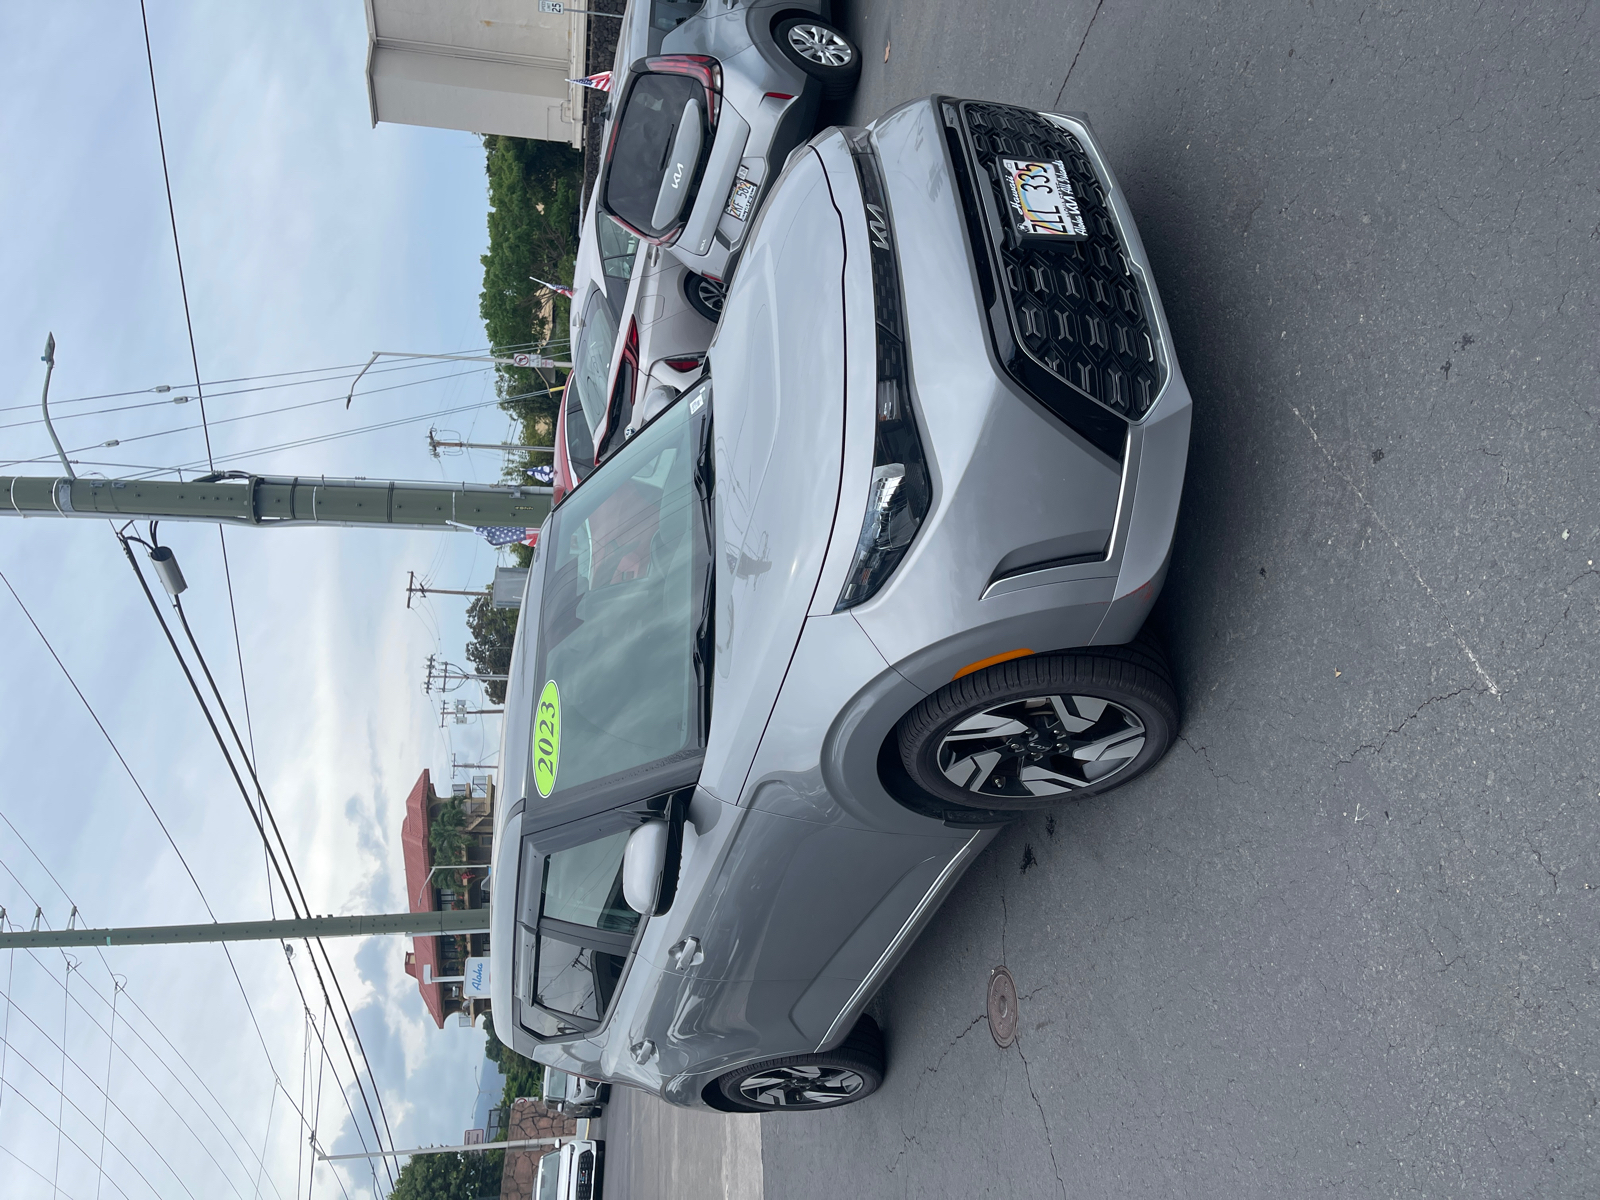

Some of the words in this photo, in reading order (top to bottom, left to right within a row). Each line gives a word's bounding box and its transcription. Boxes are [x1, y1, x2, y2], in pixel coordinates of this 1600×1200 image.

[551, 3, 561, 13] 25
[671, 163, 684, 189] KIA
[1014, 162, 1053, 194] 335
[1052, 159, 1070, 183] Islands
[729, 200, 743, 217] ZKF
[736, 181, 751, 199] 582
[1005, 175, 1023, 215] Hawaii
[1060, 184, 1073, 194] All
[1063, 195, 1080, 215] KIA
[867, 203, 889, 250] KIA
[1027, 205, 1068, 234] ZLL
[1073, 215, 1088, 236] Aloha
[537, 701, 555, 776] 2023
[472, 963, 483, 991] Aloha
